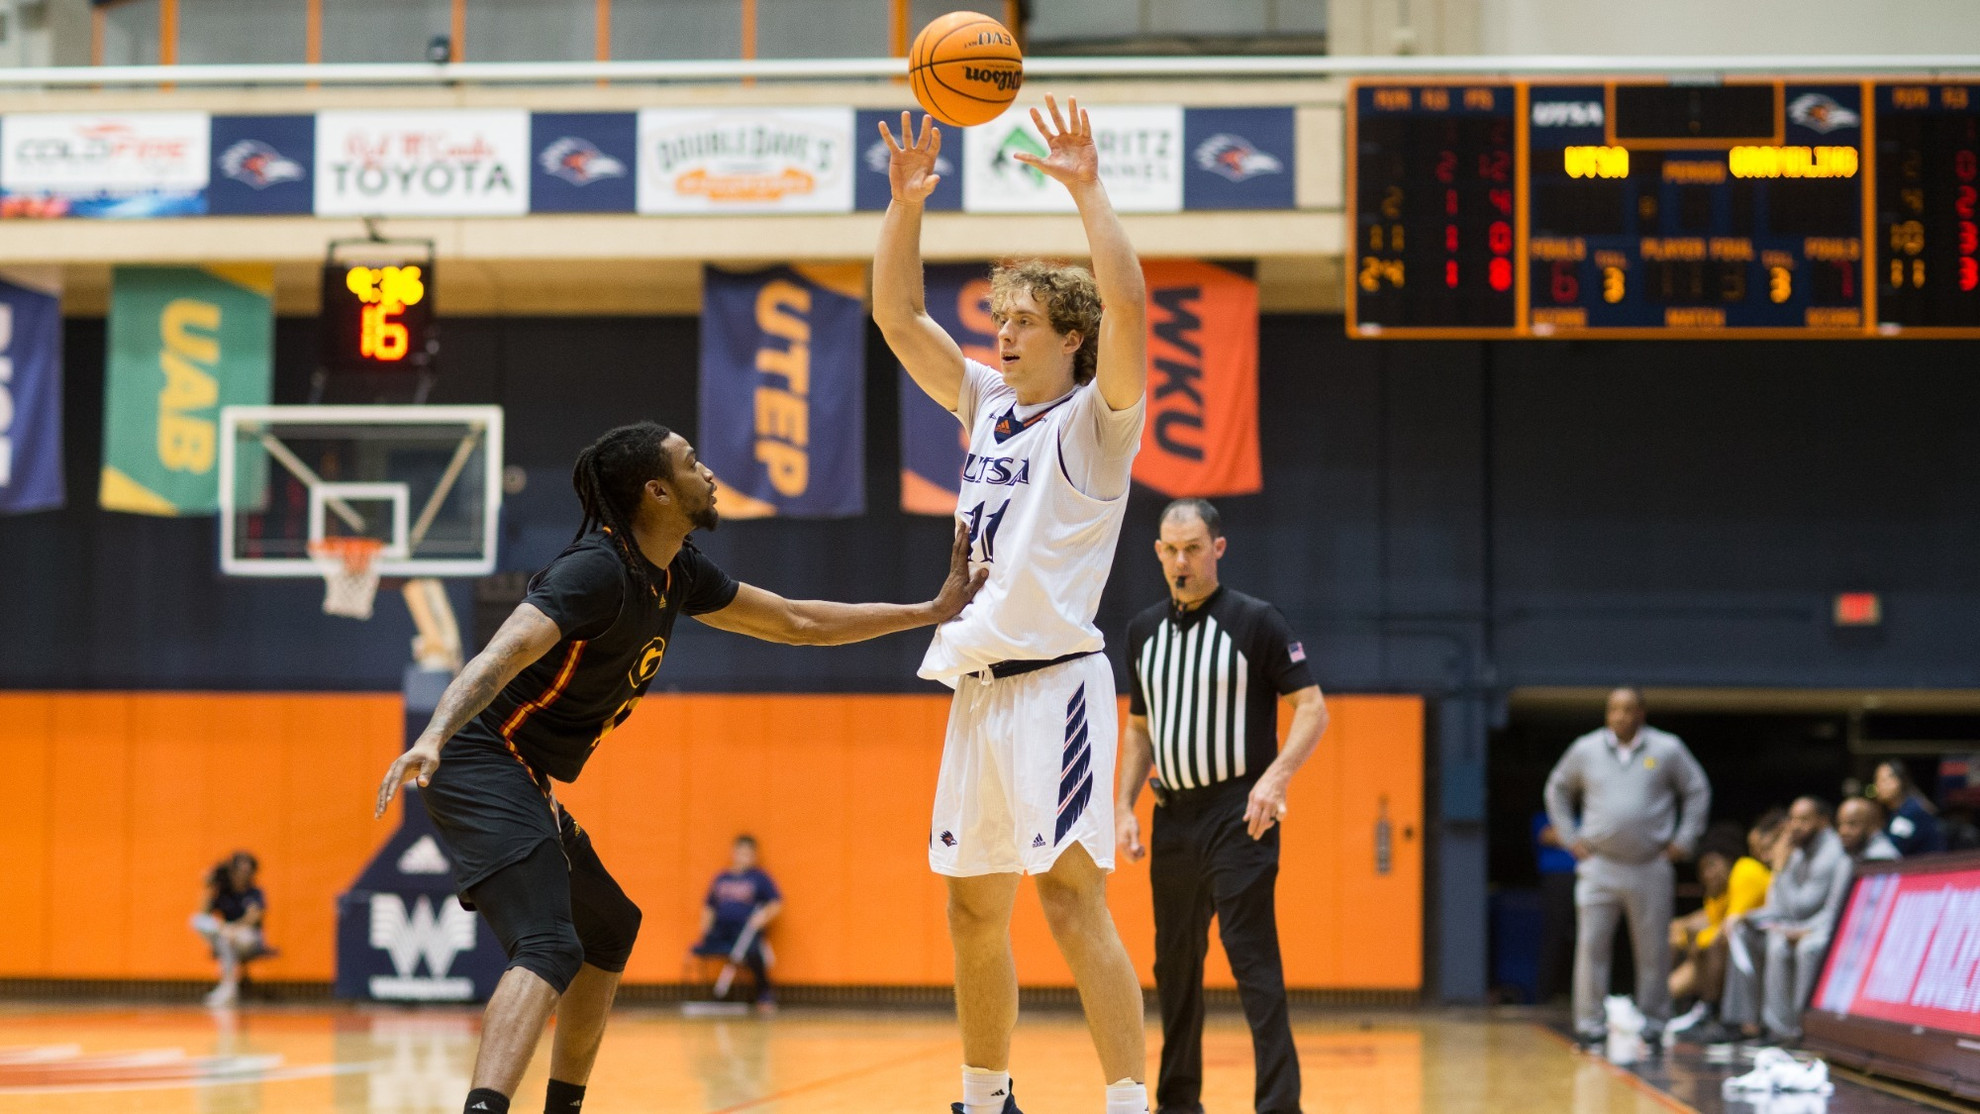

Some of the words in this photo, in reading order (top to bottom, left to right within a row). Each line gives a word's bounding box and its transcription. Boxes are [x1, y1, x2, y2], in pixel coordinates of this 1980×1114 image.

[332, 162, 514, 196] TOYOTA
[158, 298, 222, 475] UAB
[360, 302, 409, 361] 16
[755, 279, 812, 498] UTEP
[1153, 285, 1205, 462] WKU
[963, 453, 1030, 487] UTSA
